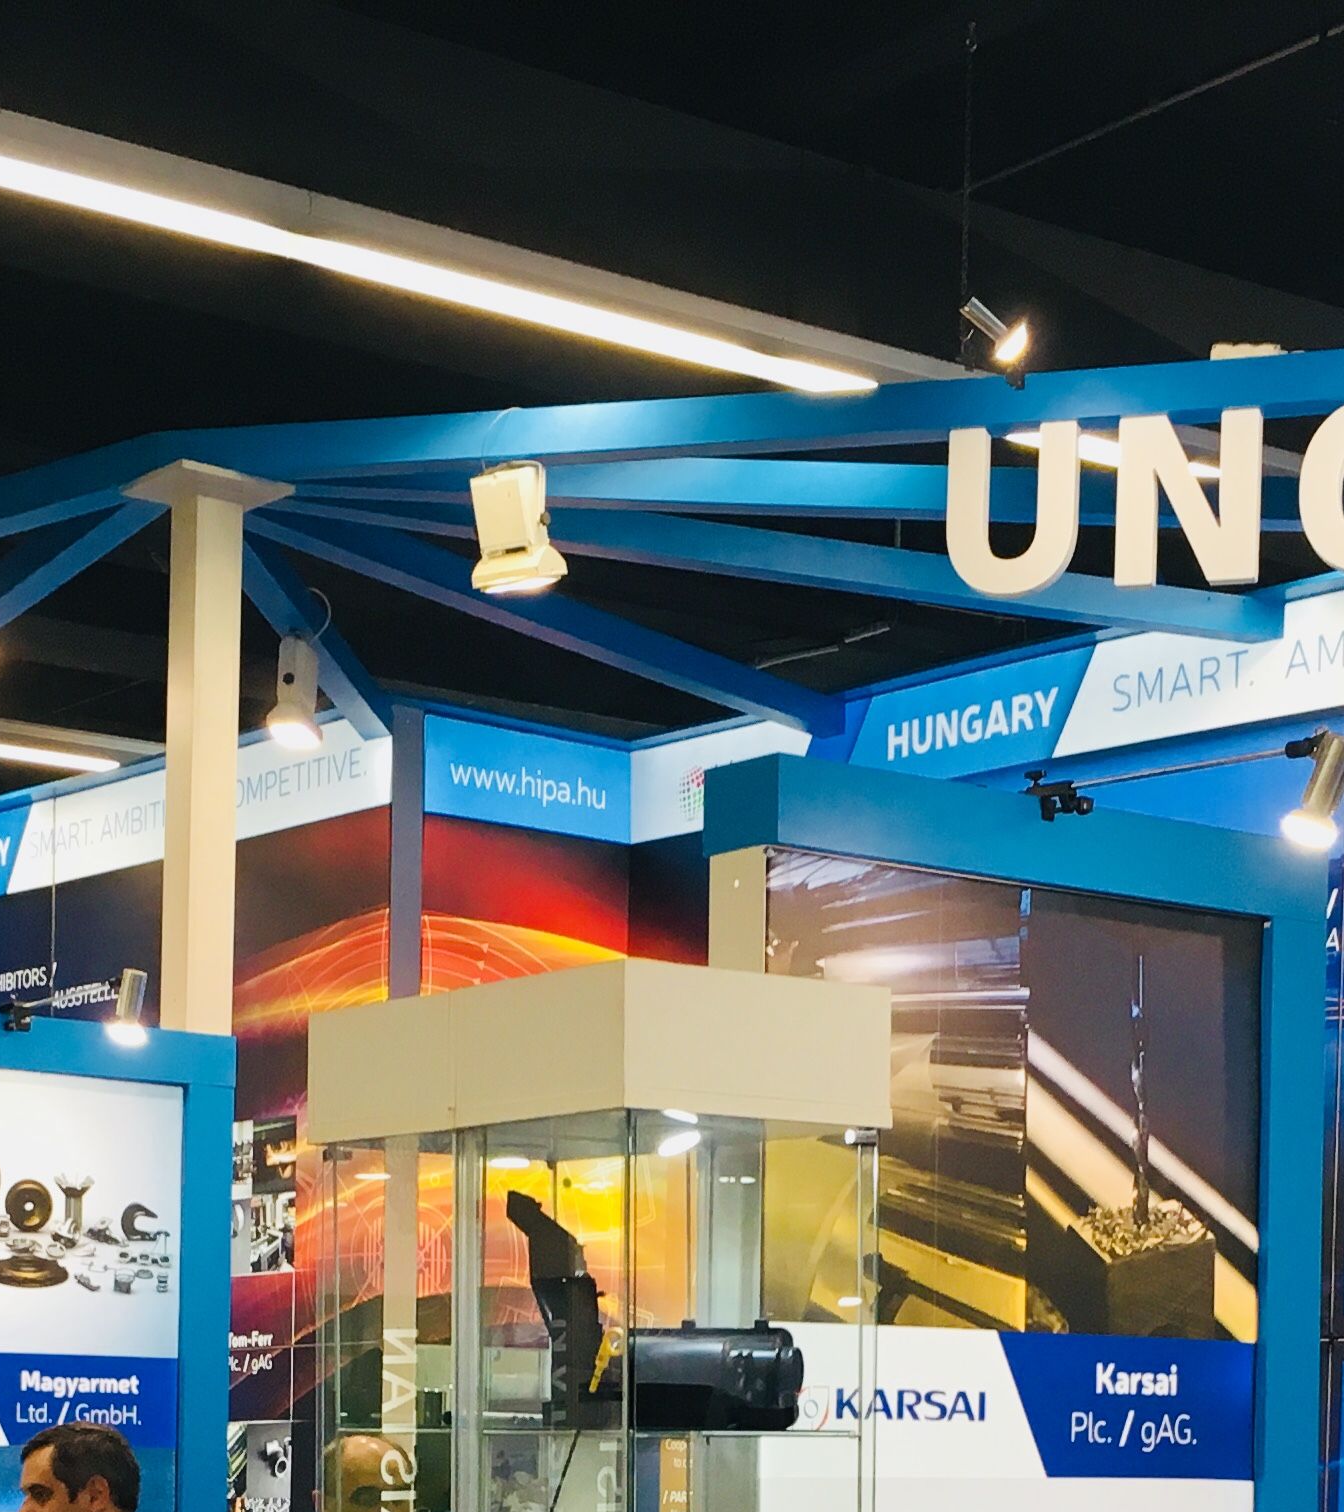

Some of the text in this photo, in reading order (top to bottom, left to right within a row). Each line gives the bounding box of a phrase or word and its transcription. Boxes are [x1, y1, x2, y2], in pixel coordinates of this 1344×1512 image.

[1112, 648, 1254, 713] SMART.
[887, 686, 1059, 762] HUNGARY
[236, 747, 367, 808] OMPETITIVE.
[450, 761, 606, 810] www.hipa.hu
[30, 818, 93, 859] SMART.
[20, 1370, 139, 1398] Magyarmet
[1094, 1362, 1178, 1397] Karsai
[16, 1402, 52, 1423] Ltd.
[75, 1403, 142, 1426] GmbH.
[836, 1387, 986, 1422] KARSAI
[1070, 1411, 1112, 1444] Plc.
[1141, 1414, 1197, 1452] gAG.
